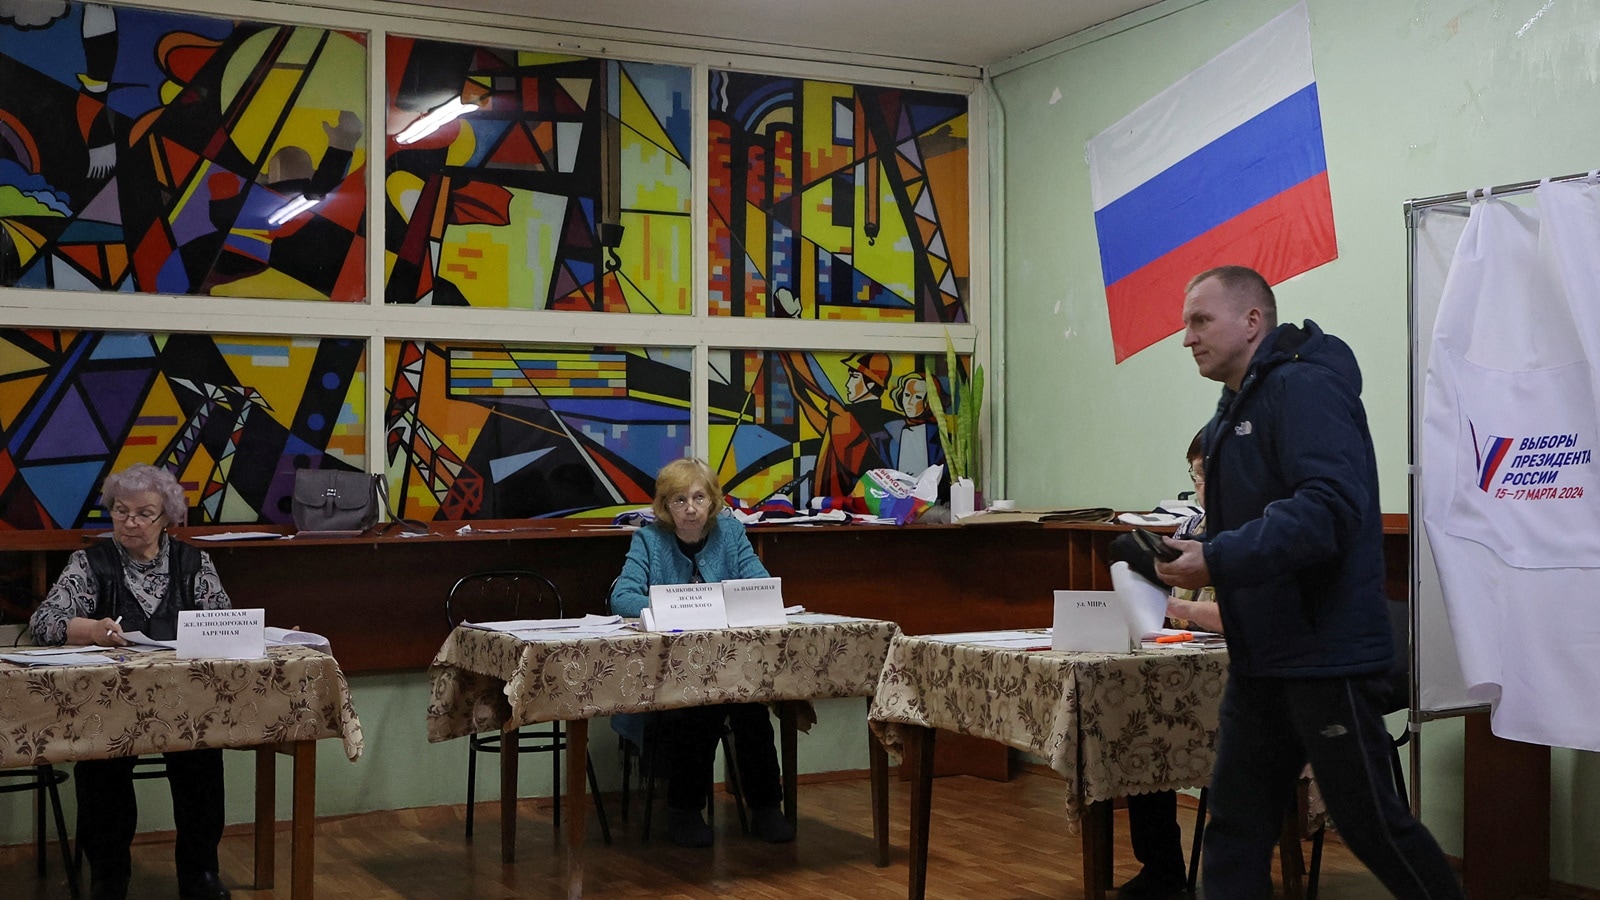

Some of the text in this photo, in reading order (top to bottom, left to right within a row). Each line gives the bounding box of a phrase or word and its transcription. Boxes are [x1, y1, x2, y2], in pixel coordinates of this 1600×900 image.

[1519, 433, 1578, 450] ВЫБОРЫ
[1511, 449, 1591, 468] ПРЕЗИДЕНТА
[1502, 470, 1559, 486] РОССИИ
[1525, 487, 1558, 500] МАРТА
[1558, 486, 1584, 499] 2024
[183, 620, 258, 628] ЖЕЛЕЗНОДОРОЖНАЯ
